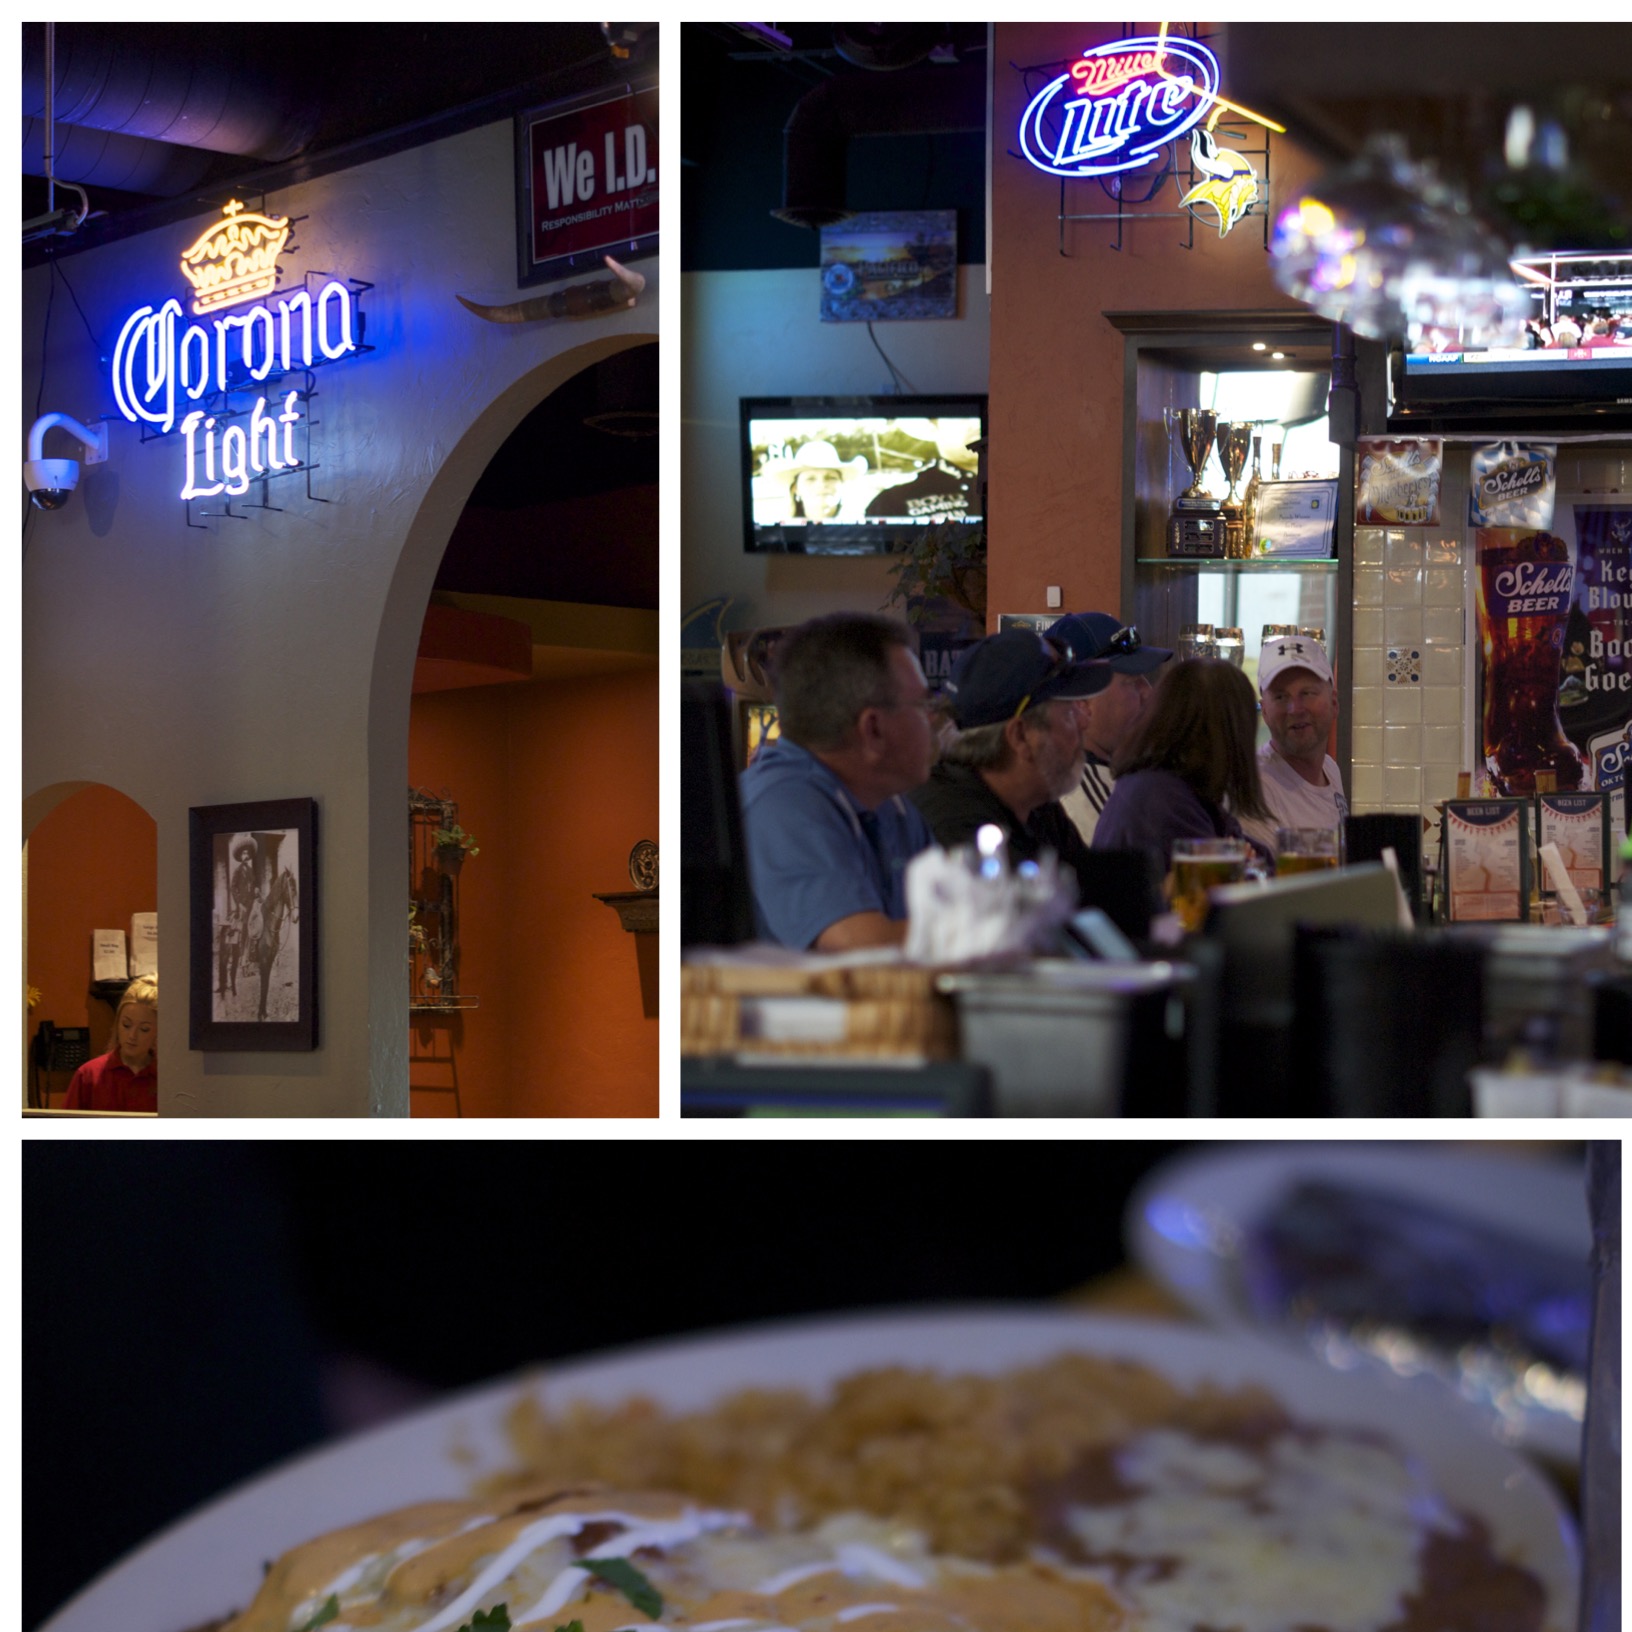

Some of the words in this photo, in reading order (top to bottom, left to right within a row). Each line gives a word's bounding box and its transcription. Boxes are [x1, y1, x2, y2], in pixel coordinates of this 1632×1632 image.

[1071, 52, 1167, 95] Miller
[1053, 76, 1194, 165] Lite
[543, 142, 595, 210] We
[605, 124, 657, 194] I.D.
[112, 281, 355, 431] Corona
[181, 391, 301, 500] Light
[908, 500, 969, 516] GAMING
[1498, 486, 1528, 501] BEER
[1507, 596, 1559, 614] BEER
